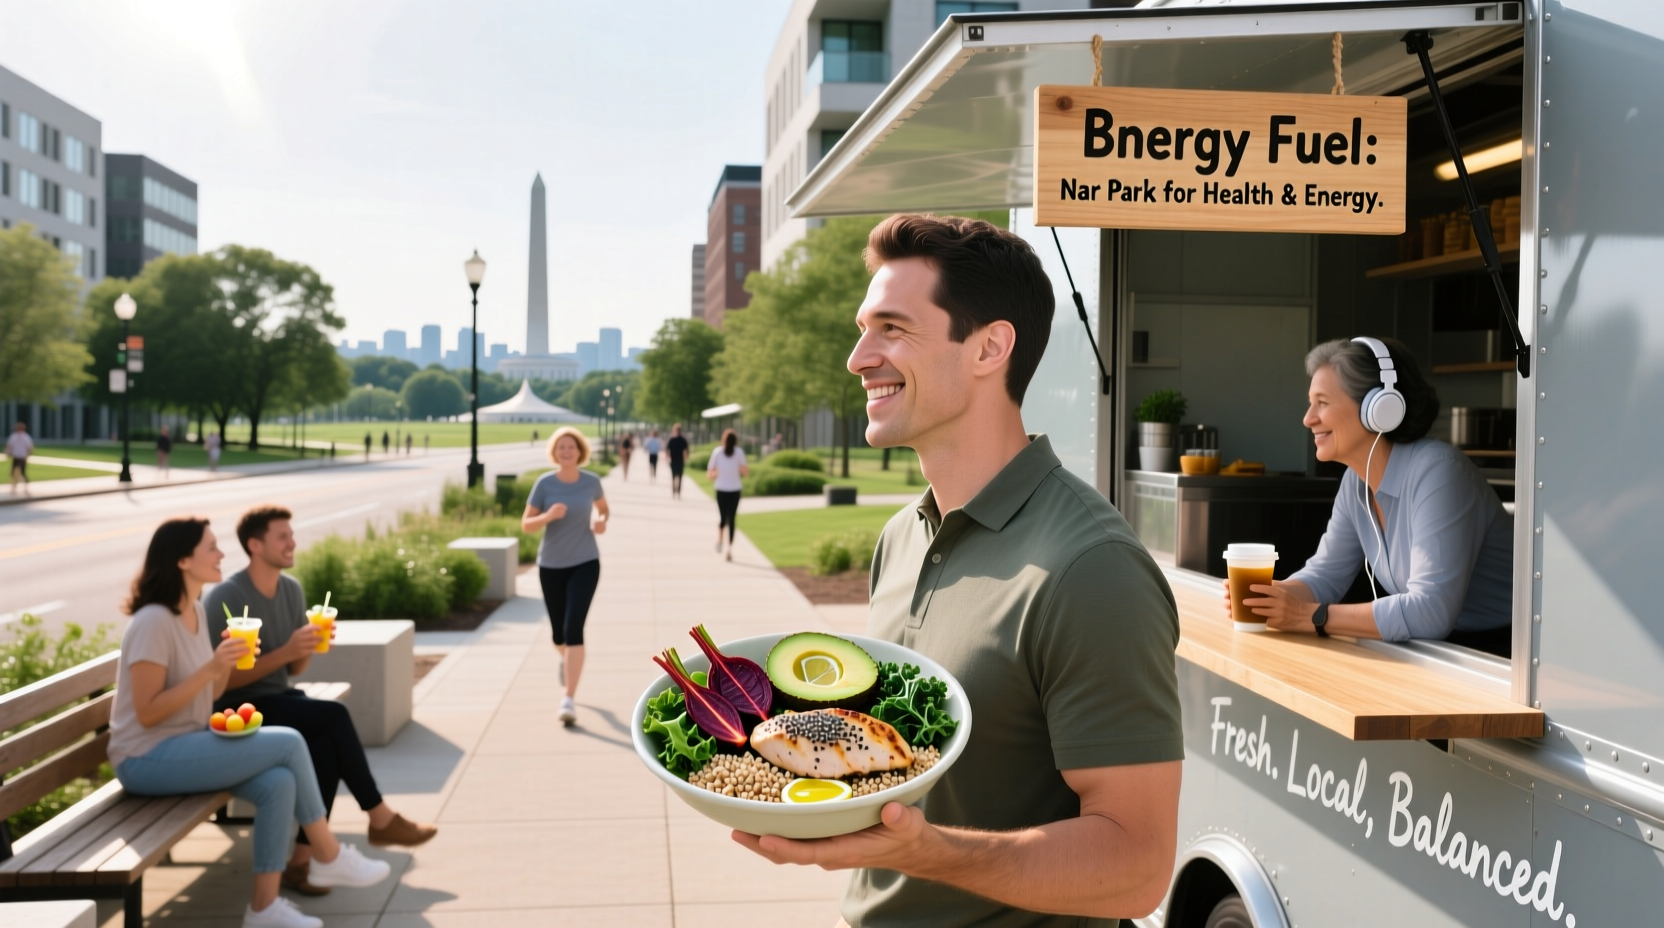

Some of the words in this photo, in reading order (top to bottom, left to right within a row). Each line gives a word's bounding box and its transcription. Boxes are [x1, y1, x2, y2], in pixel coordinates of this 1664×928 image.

[1083, 108, 1251, 177] Bnergy
[1268, 115, 1378, 165] Fuel:
[1060, 178, 1101, 201] Nar
[1107, 179, 1156, 203] Park
[1163, 180, 1197, 203] for
[1203, 181, 1273, 205] Health
[1281, 183, 1297, 206] &
[1305, 184, 1384, 214] Energy.
[1210, 697, 1278, 780] Fresh.
[1287, 729, 1374, 838] Local,
[1388, 771, 1576, 928] Balanced.
